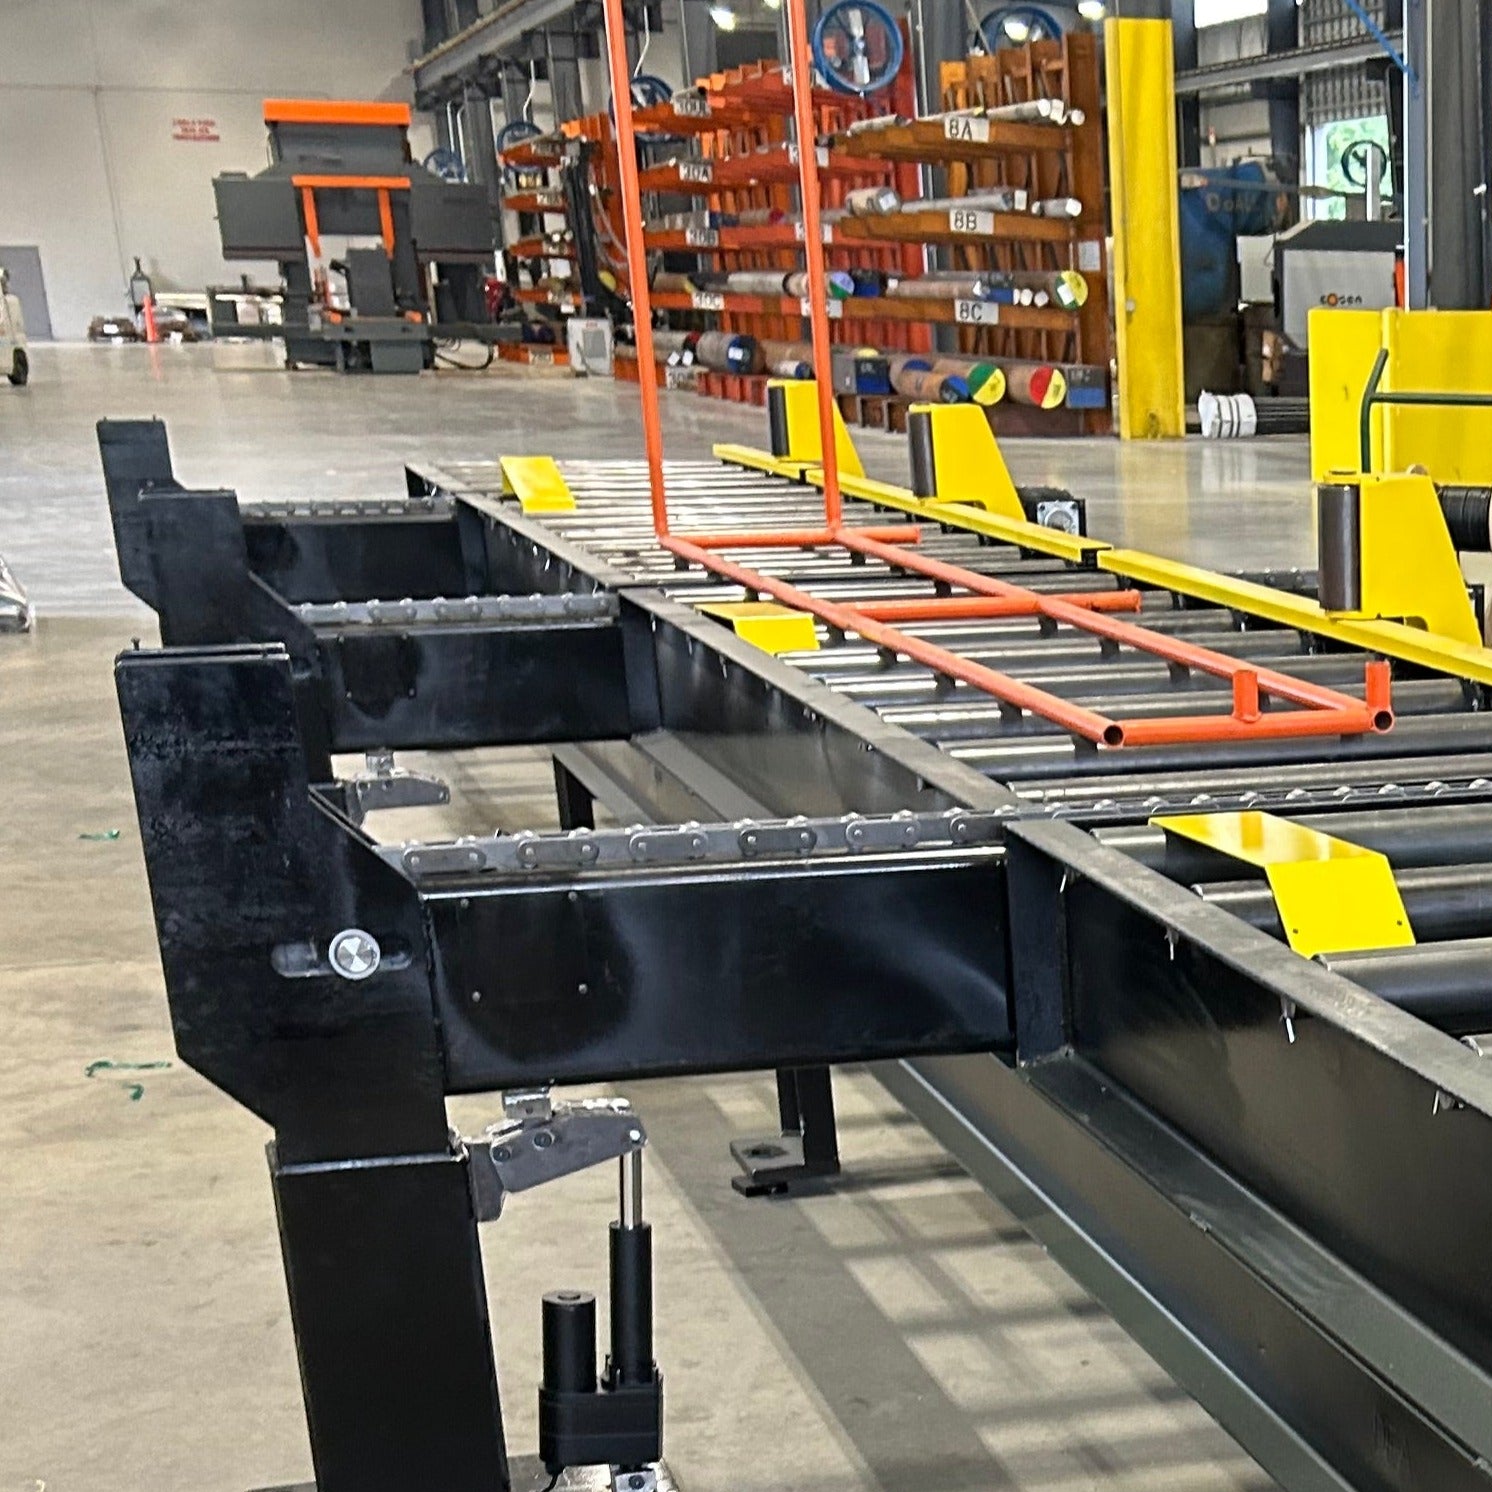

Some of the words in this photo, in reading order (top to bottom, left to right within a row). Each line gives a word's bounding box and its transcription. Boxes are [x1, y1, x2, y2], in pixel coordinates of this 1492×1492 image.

[949, 118, 973, 140] 8A
[954, 210, 977, 231] 8B
[959, 302, 983, 321] 8C
